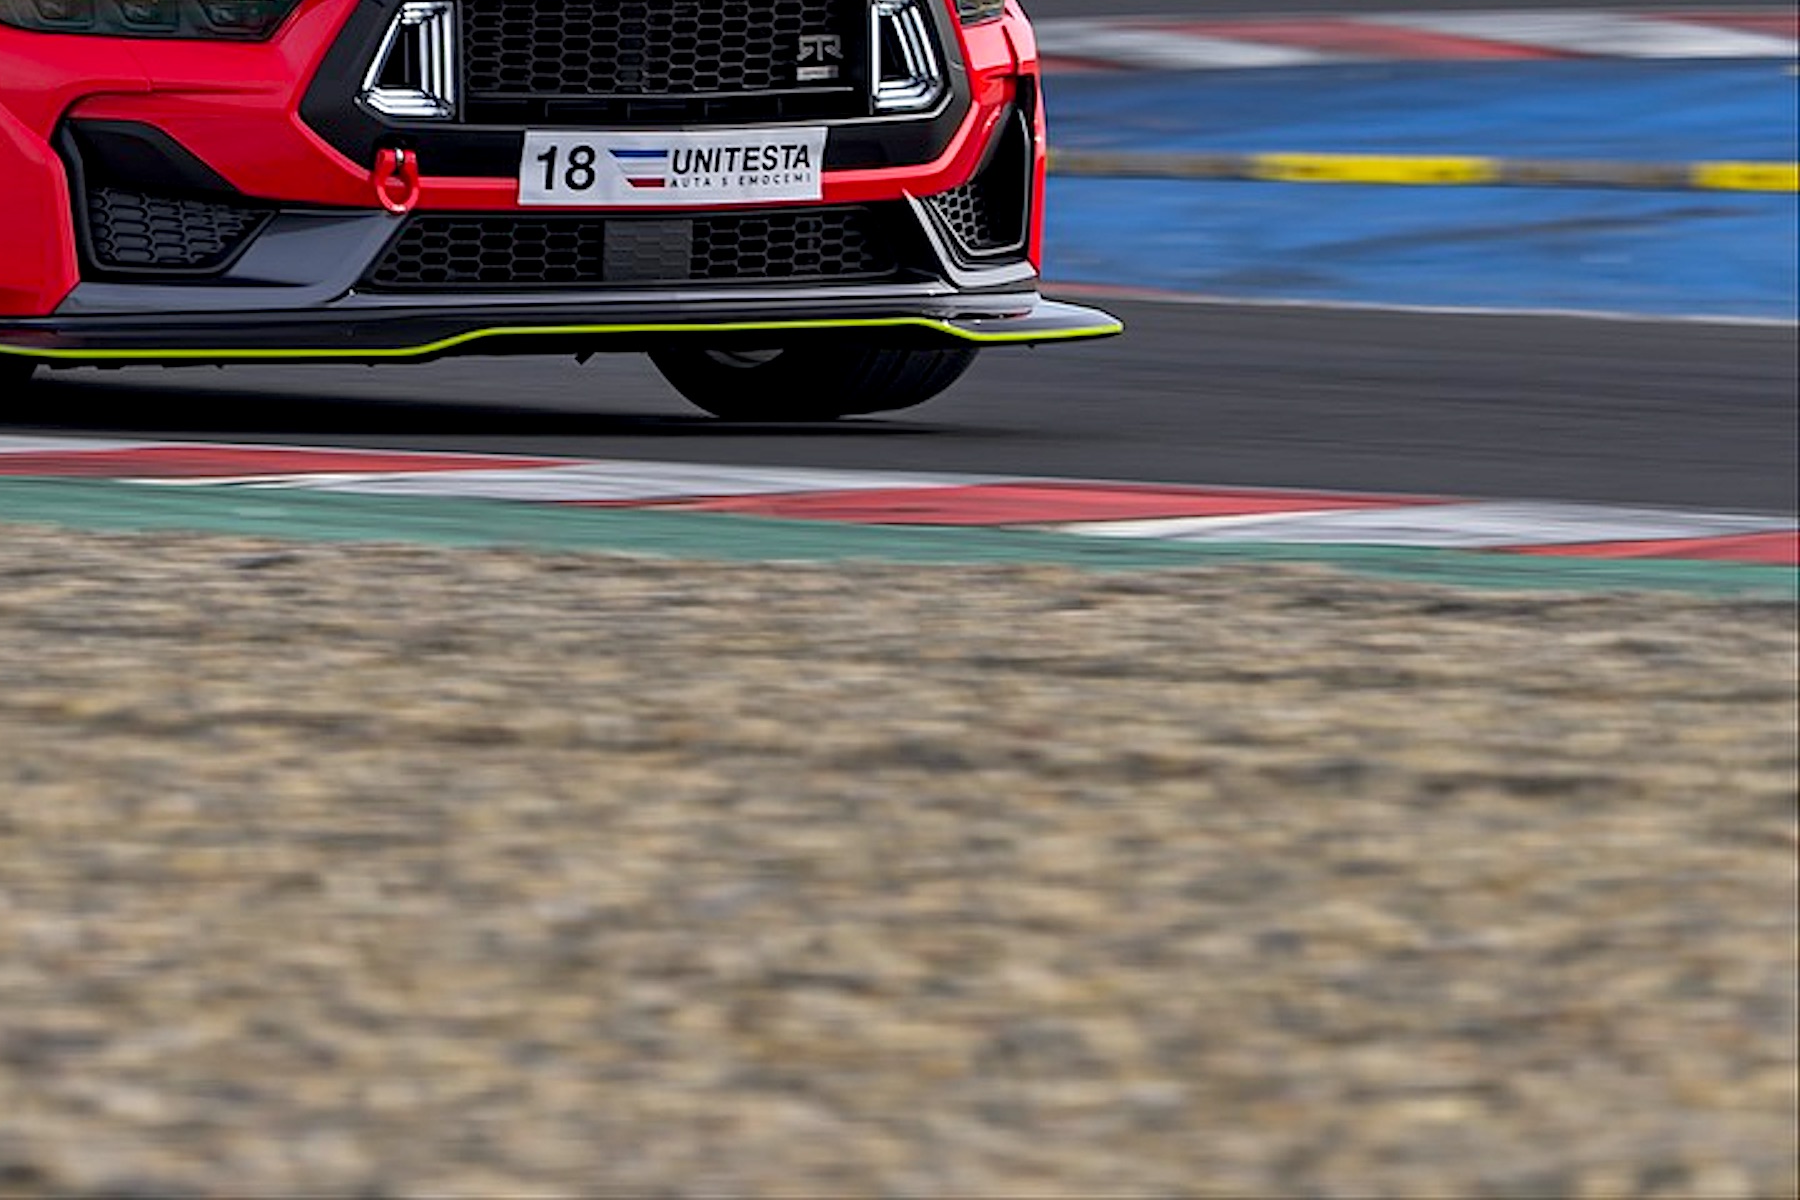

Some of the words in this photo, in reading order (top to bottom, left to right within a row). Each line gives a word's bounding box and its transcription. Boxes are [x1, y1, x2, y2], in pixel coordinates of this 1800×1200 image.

[537, 145, 596, 190] 18
[672, 144, 811, 175] UNITESTA
[670, 177, 711, 188] AUTA
[739, 173, 811, 186] EMOCEMI
